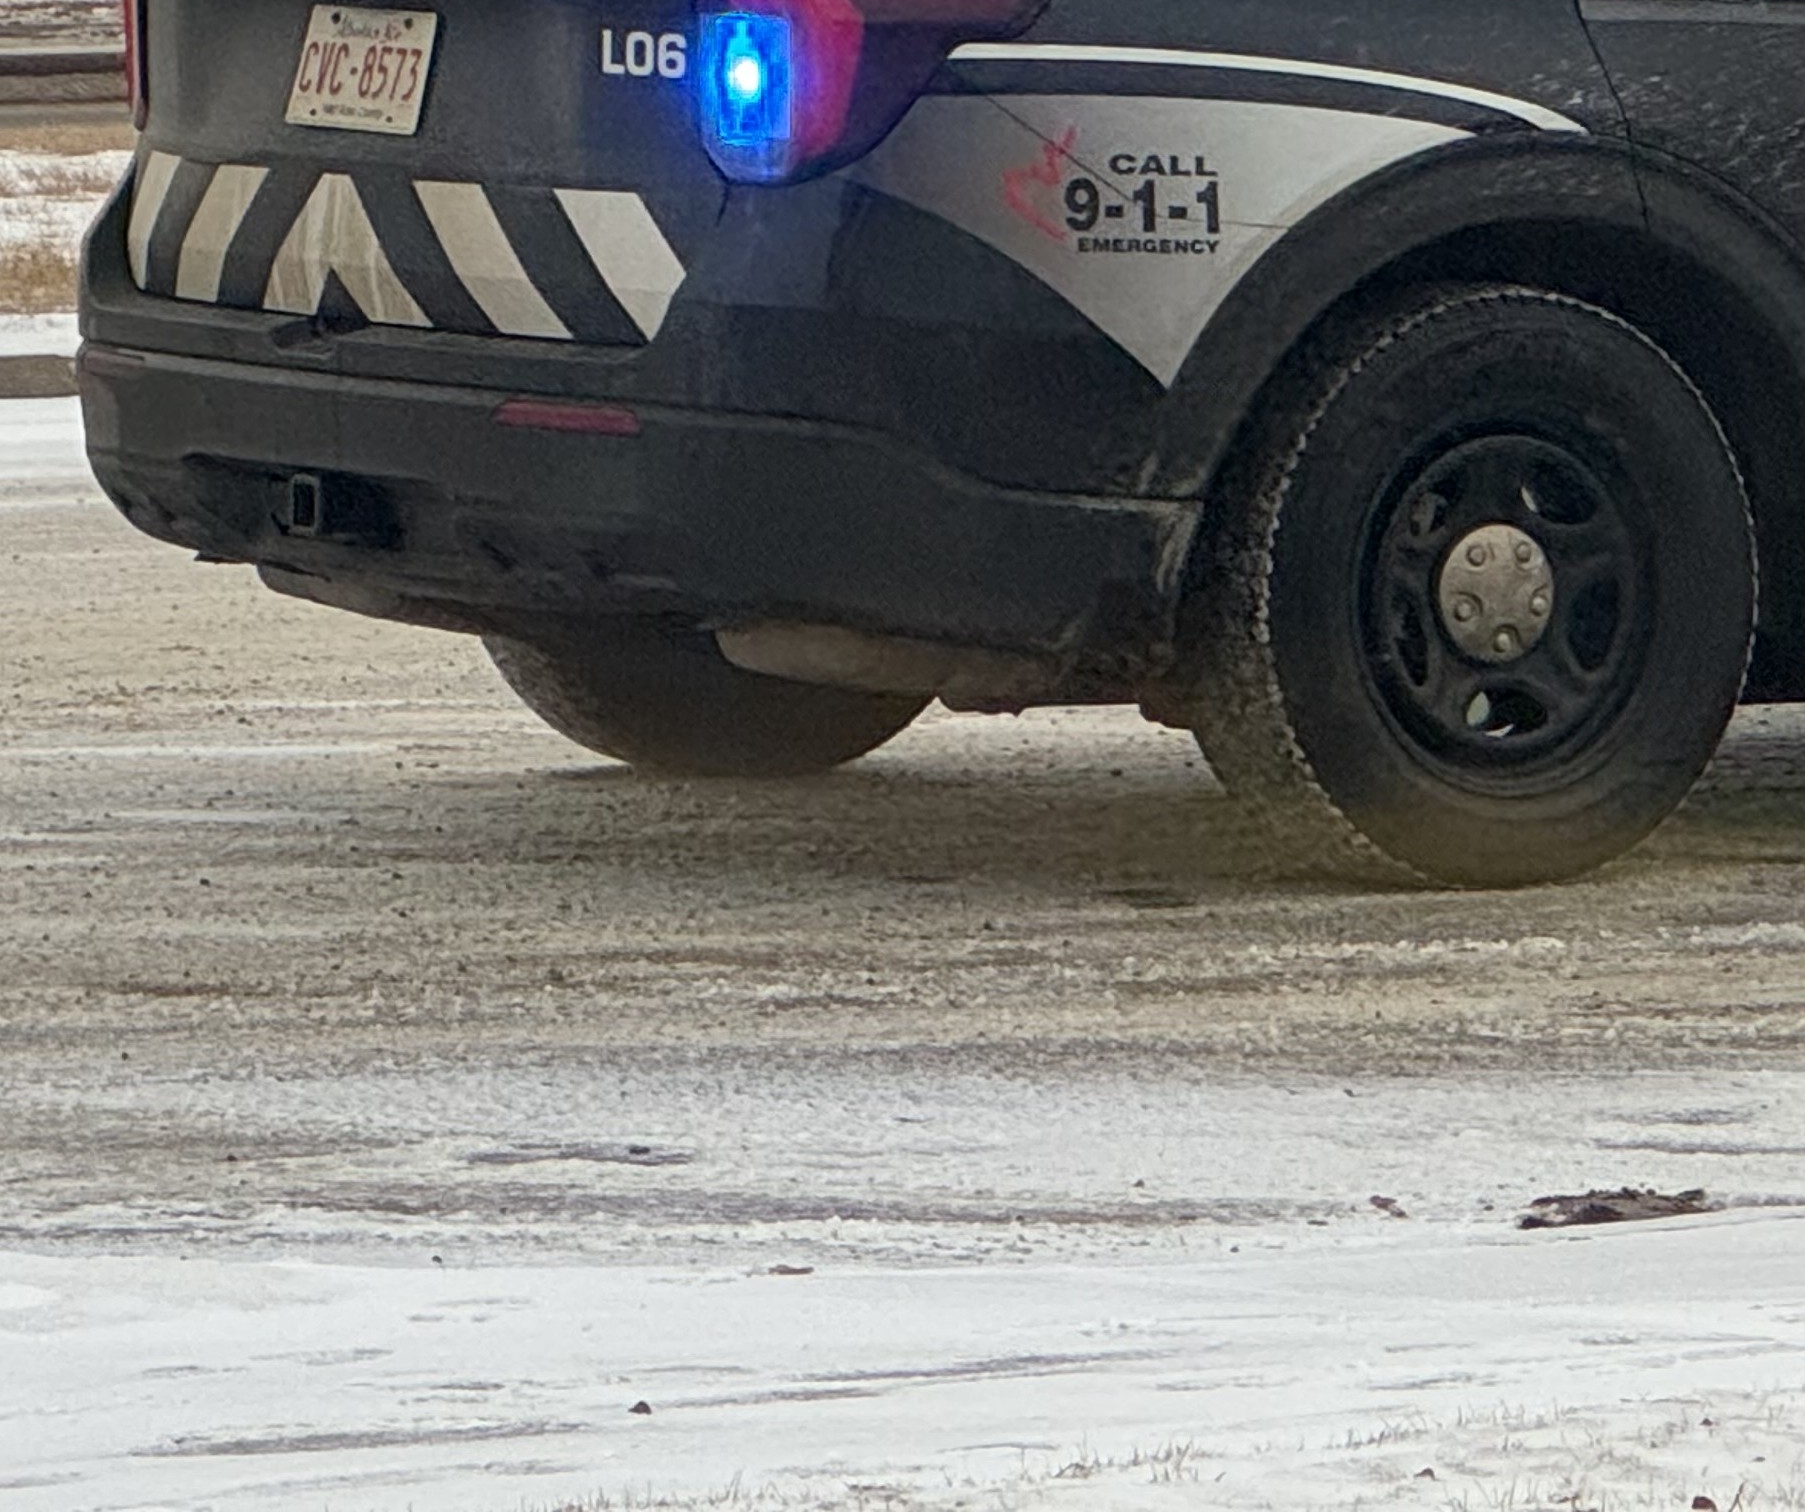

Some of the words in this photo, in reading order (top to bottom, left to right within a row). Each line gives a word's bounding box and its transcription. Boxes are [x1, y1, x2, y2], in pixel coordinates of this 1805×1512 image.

[1109, 153, 1218, 176] CALL
[1064, 177, 1220, 234] 9-1-1
[1077, 238, 1220, 254] EMERGENCY
